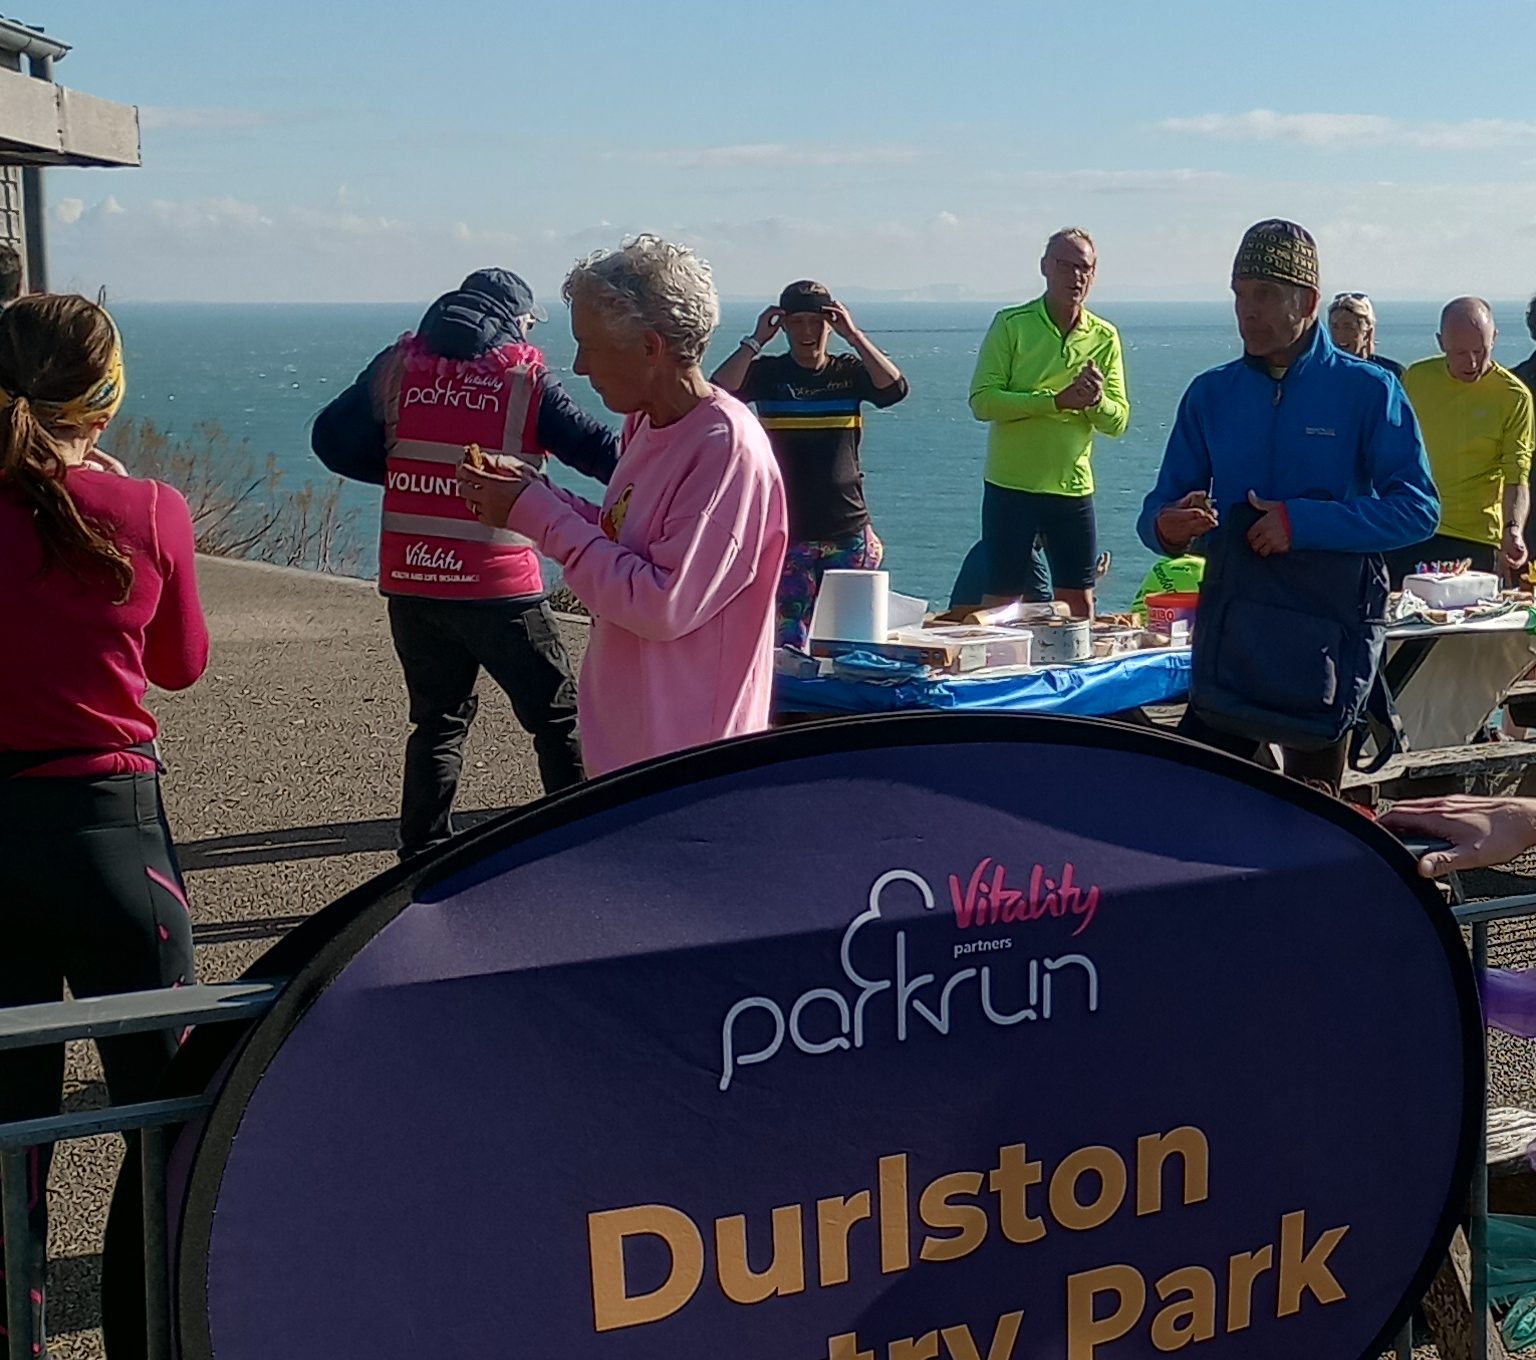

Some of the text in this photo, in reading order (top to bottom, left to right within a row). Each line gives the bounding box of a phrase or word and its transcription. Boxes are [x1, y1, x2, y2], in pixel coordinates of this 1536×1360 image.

[404, 376, 499, 413] parkrun
[949, 857, 1100, 936] Vitality
[720, 869, 1098, 1090] parkrun
[953, 937, 1013, 959] partners
[587, 1125, 1210, 1332] Durlston
